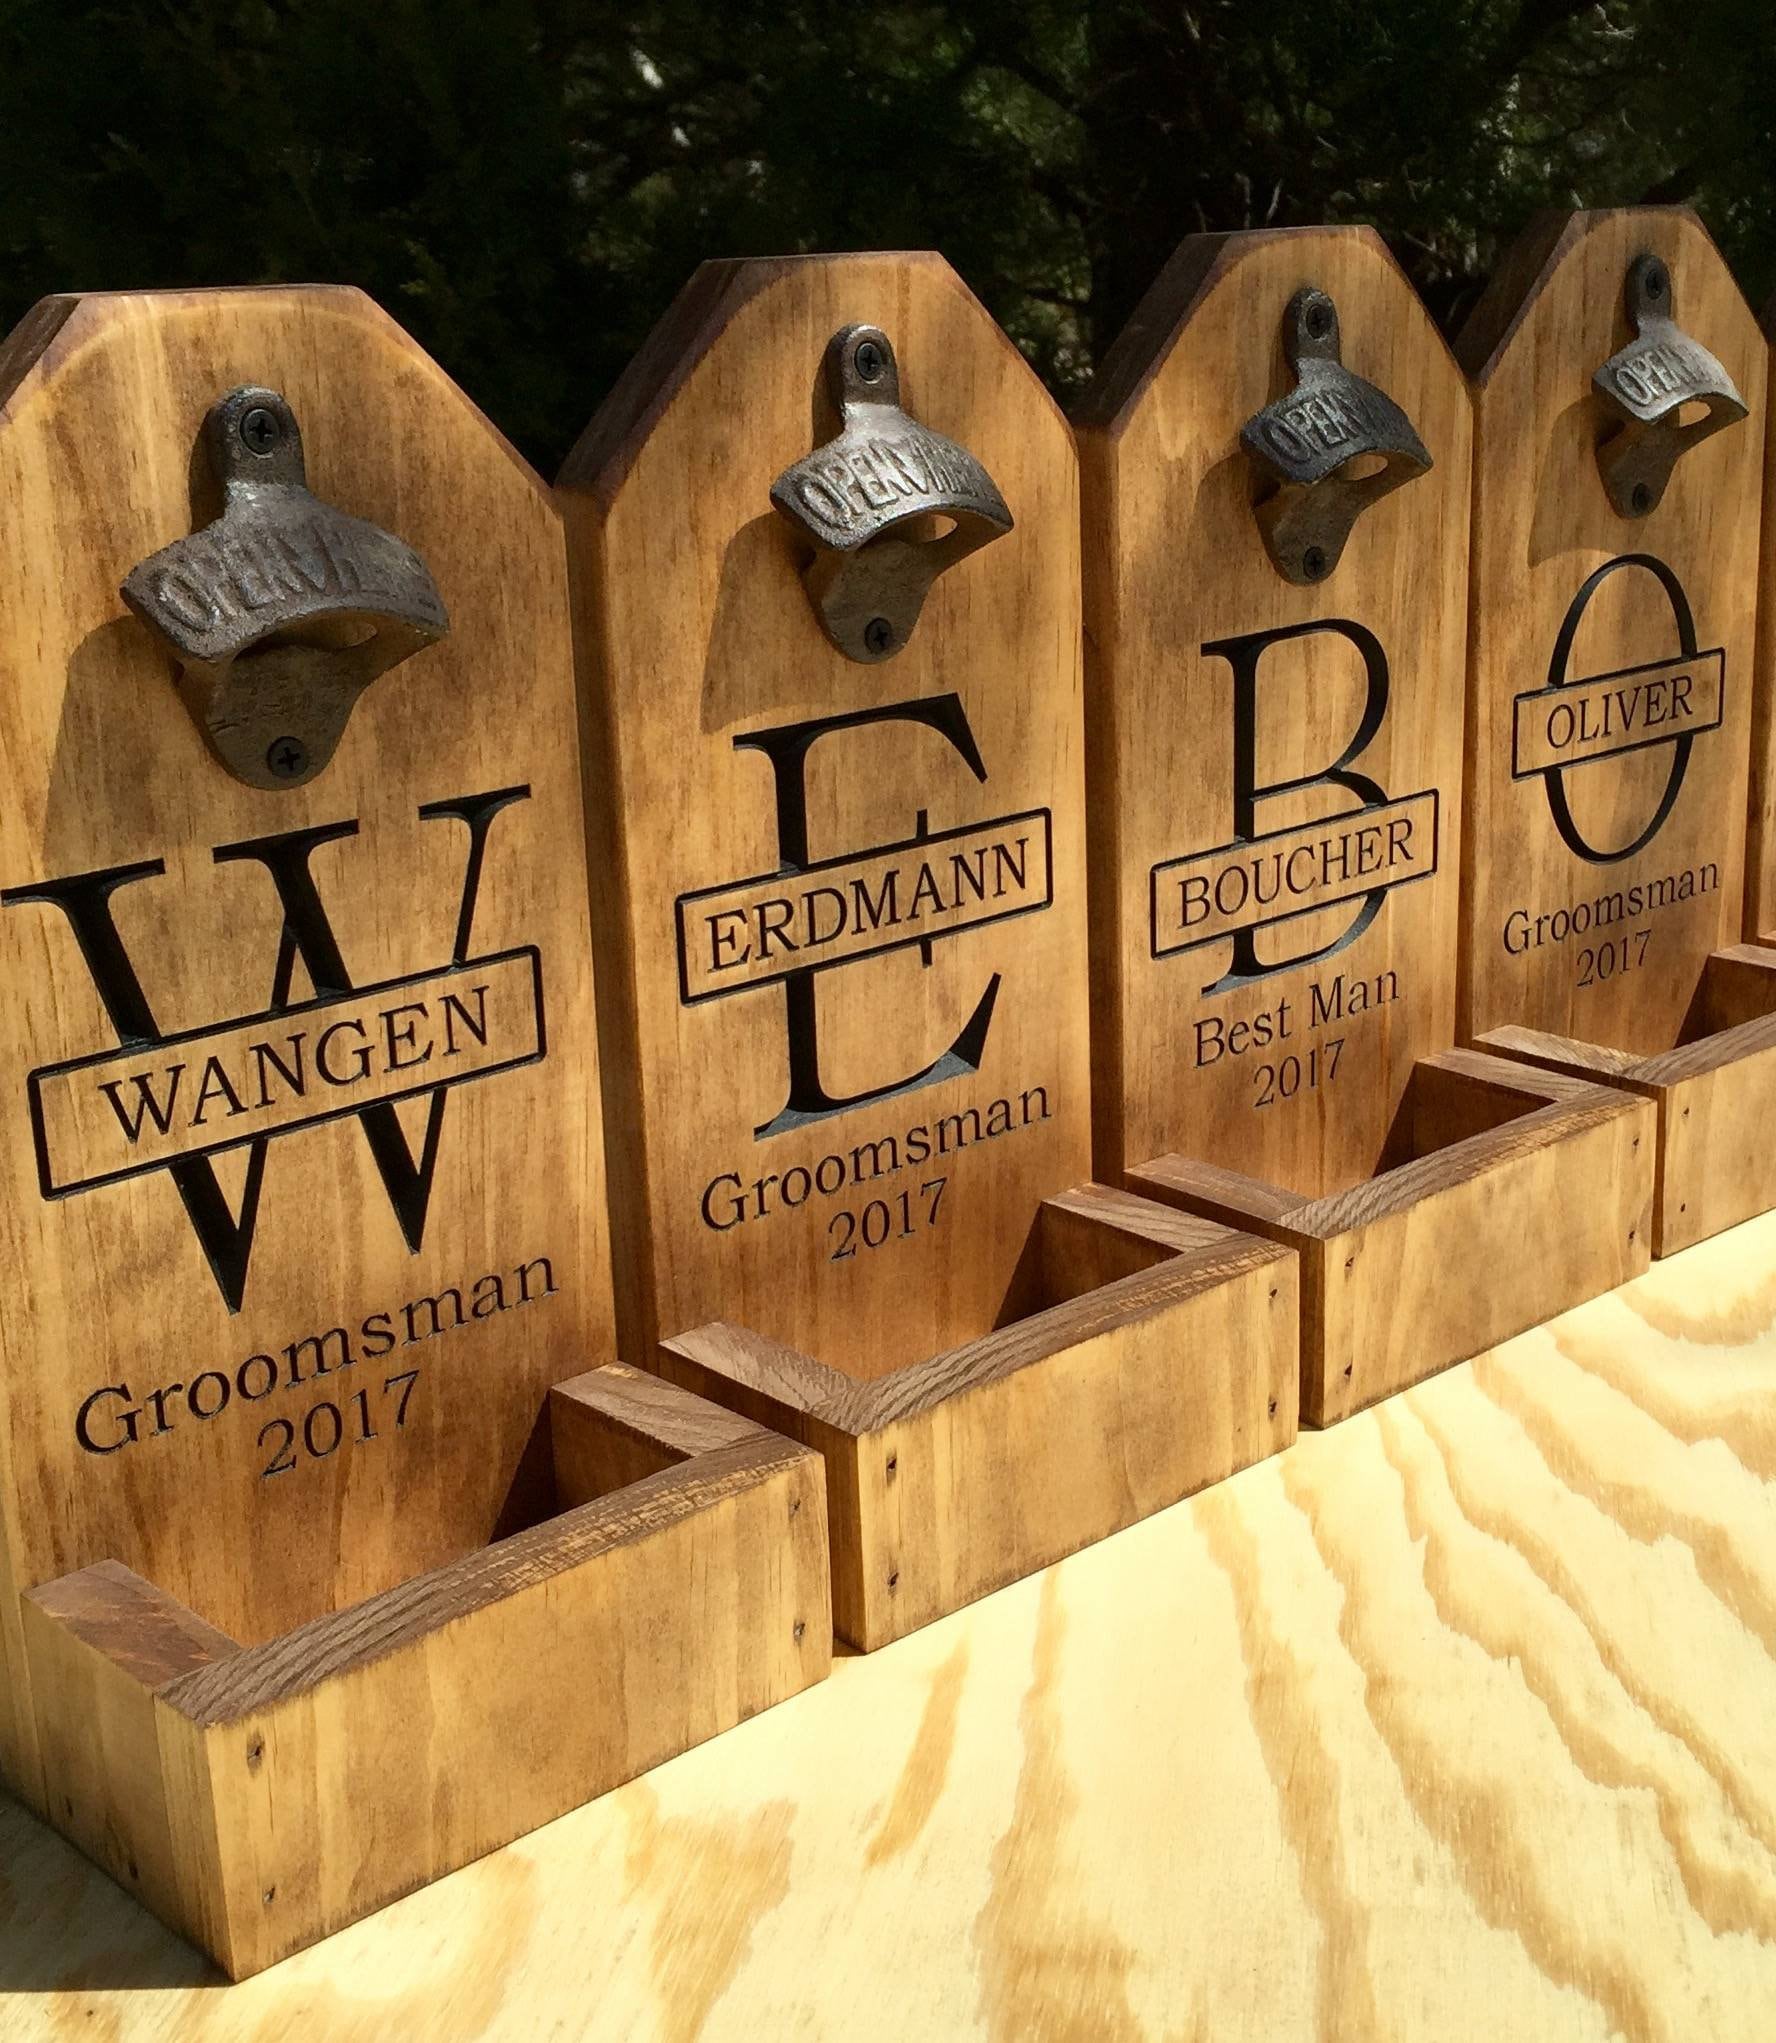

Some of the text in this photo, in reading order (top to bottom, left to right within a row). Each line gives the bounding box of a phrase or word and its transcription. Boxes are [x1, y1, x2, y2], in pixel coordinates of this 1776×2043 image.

[799, 438, 929, 530] OPEN
[1546, 675, 1694, 749] OLIVER
[705, 838, 1029, 973] ERDMANN
[1178, 818, 1415, 929] BOUCHER
[1503, 863, 1719, 956] Groomsman
[1576, 929, 1652, 987] 2017
[98, 985, 490, 1144] WANGEN
[1193, 970, 1400, 1069] Best Man
[1253, 1039, 1346, 1108] 2017
[701, 1085, 1052, 1232] Groomsman
[828, 1177, 948, 1262] 2017
[75, 1256, 558, 1456] Groomsman
[257, 1369, 421, 1479] 2017
